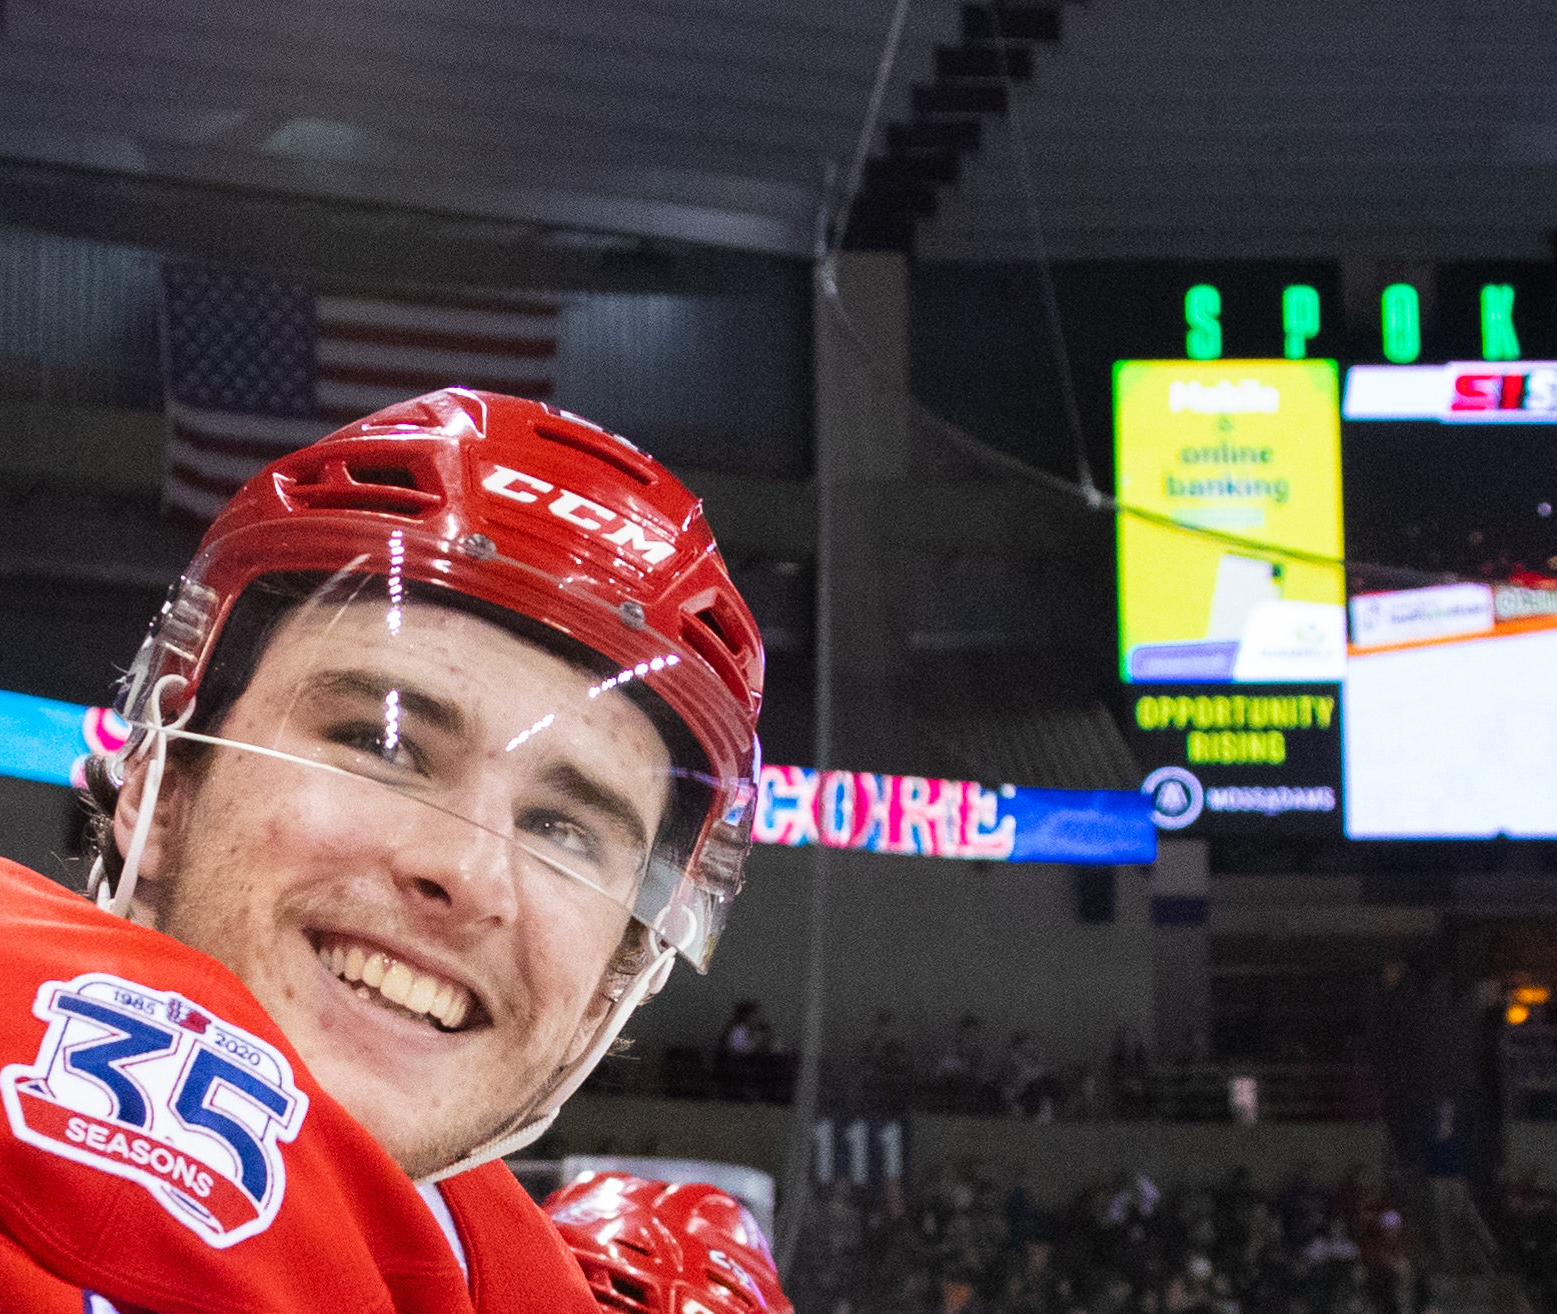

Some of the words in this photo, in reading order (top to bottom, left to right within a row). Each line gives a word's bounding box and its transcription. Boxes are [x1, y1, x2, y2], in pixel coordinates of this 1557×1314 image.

[481, 464, 677, 566] CCM
[1166, 476, 1288, 502] banking
[1136, 696, 1334, 731] OPPORTUNITY
[1187, 730, 1285, 764] RISING
[113, 989, 158, 1016] 1985
[214, 1031, 262, 1067] 2020
[49, 988, 298, 1210] 35
[64, 1116, 215, 1199] SEASONS
